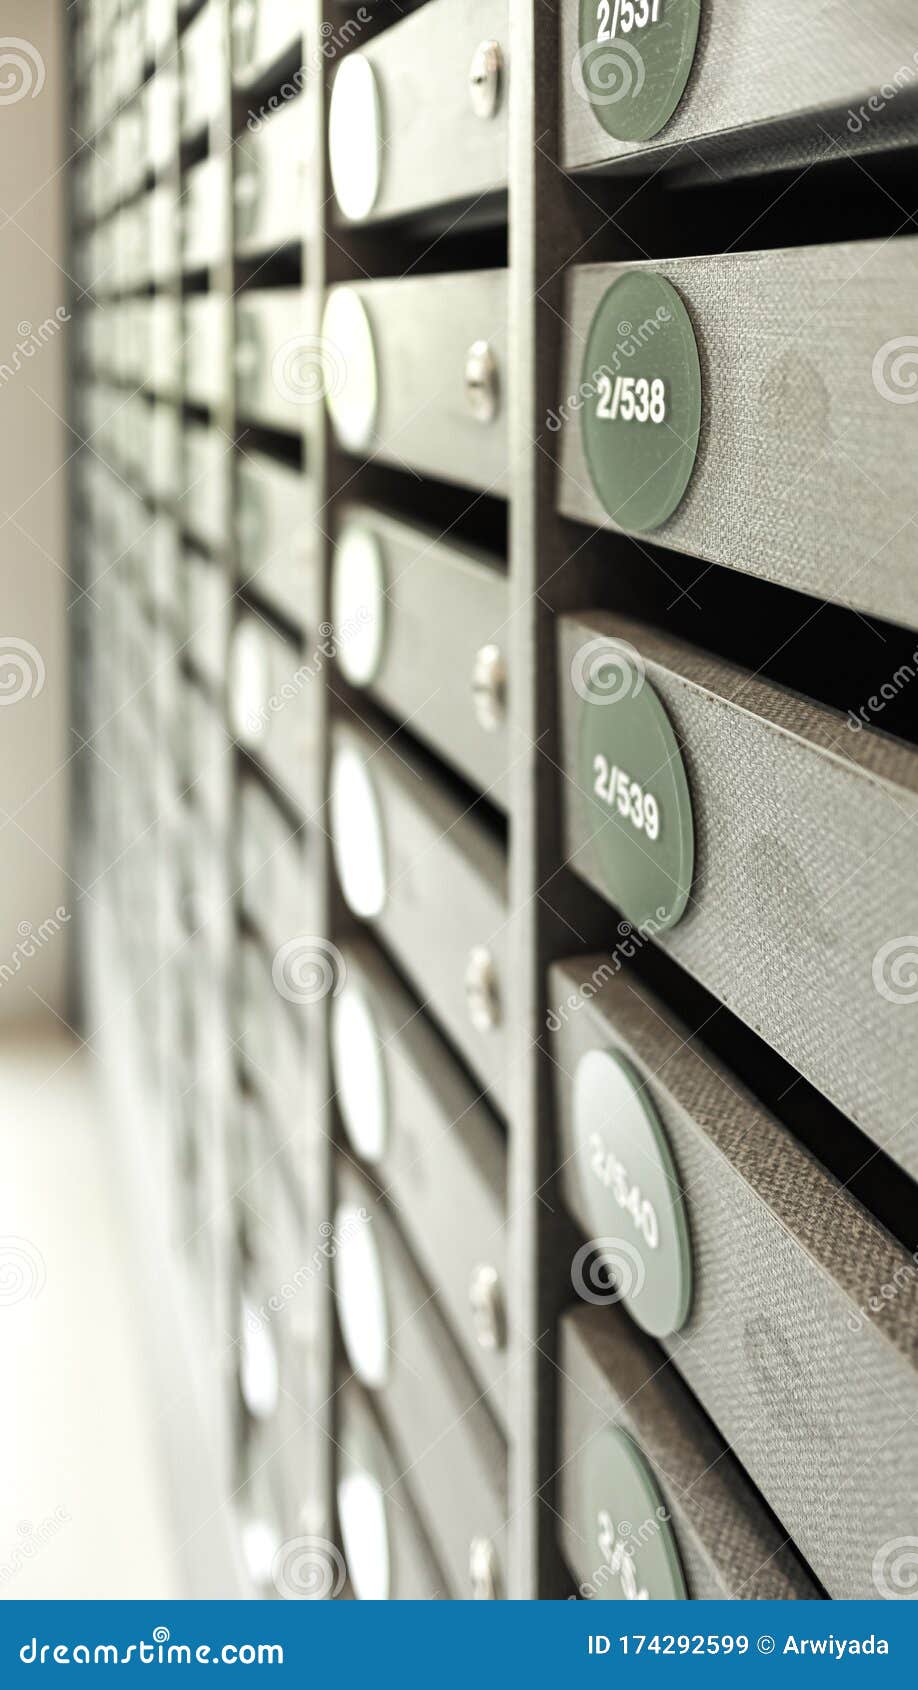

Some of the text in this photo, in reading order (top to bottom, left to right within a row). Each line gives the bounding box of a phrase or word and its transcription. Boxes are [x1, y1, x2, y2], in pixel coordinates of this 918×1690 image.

[596, 375, 666, 424] 2/538
[593, 753, 659, 841] 2/539
[590, 1132, 659, 1249] 2/540
[597, 1509, 650, 1600] 2/5
